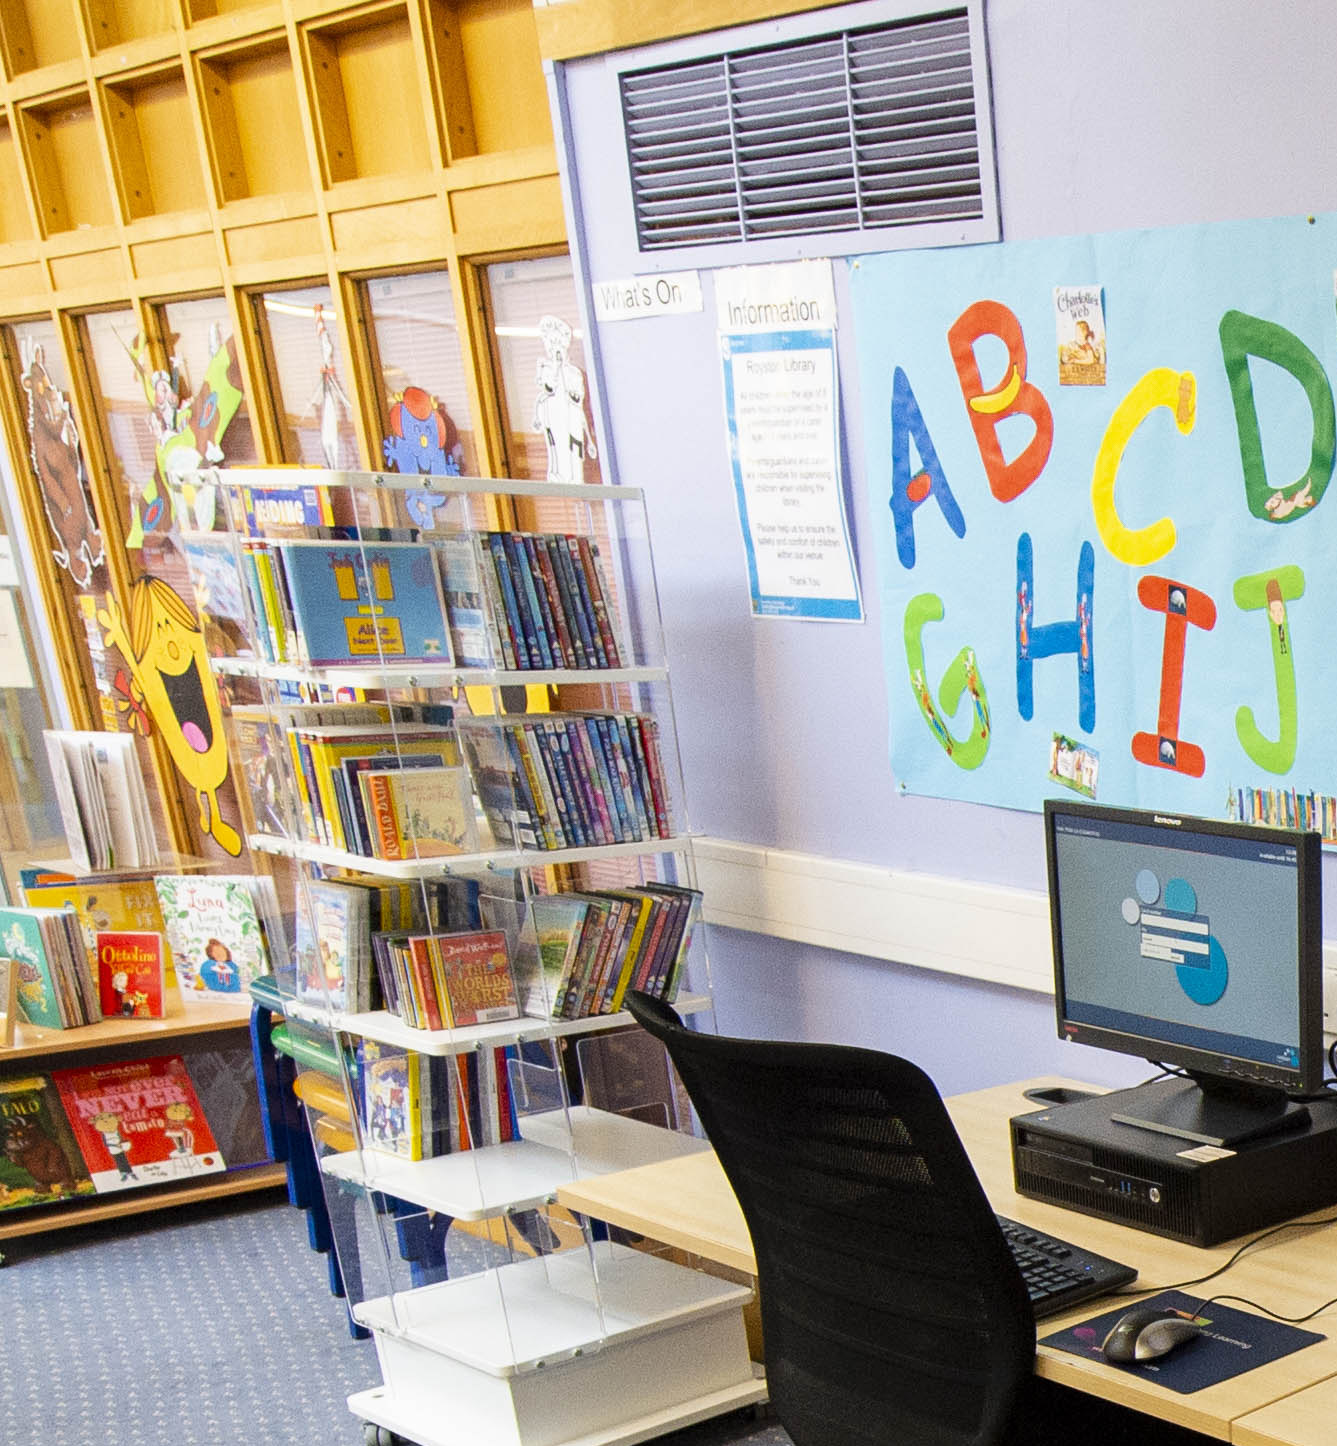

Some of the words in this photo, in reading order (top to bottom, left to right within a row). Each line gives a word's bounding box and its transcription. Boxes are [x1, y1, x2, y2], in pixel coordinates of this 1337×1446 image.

[601, 279, 651, 310] What's
[655, 279, 683, 305] On
[728, 296, 821, 326] Information
[783, 356, 816, 374] Library
[891, 366, 966, 569] A
[947, 300, 1054, 503] B
[1091, 367, 1197, 566] C
[1219, 309, 1337, 523] D
[1016, 532, 1095, 734] H
[1234, 565, 1305, 775] J
[188, 888, 225, 912] Luna
[74, 1086, 189, 1119] NEVER
